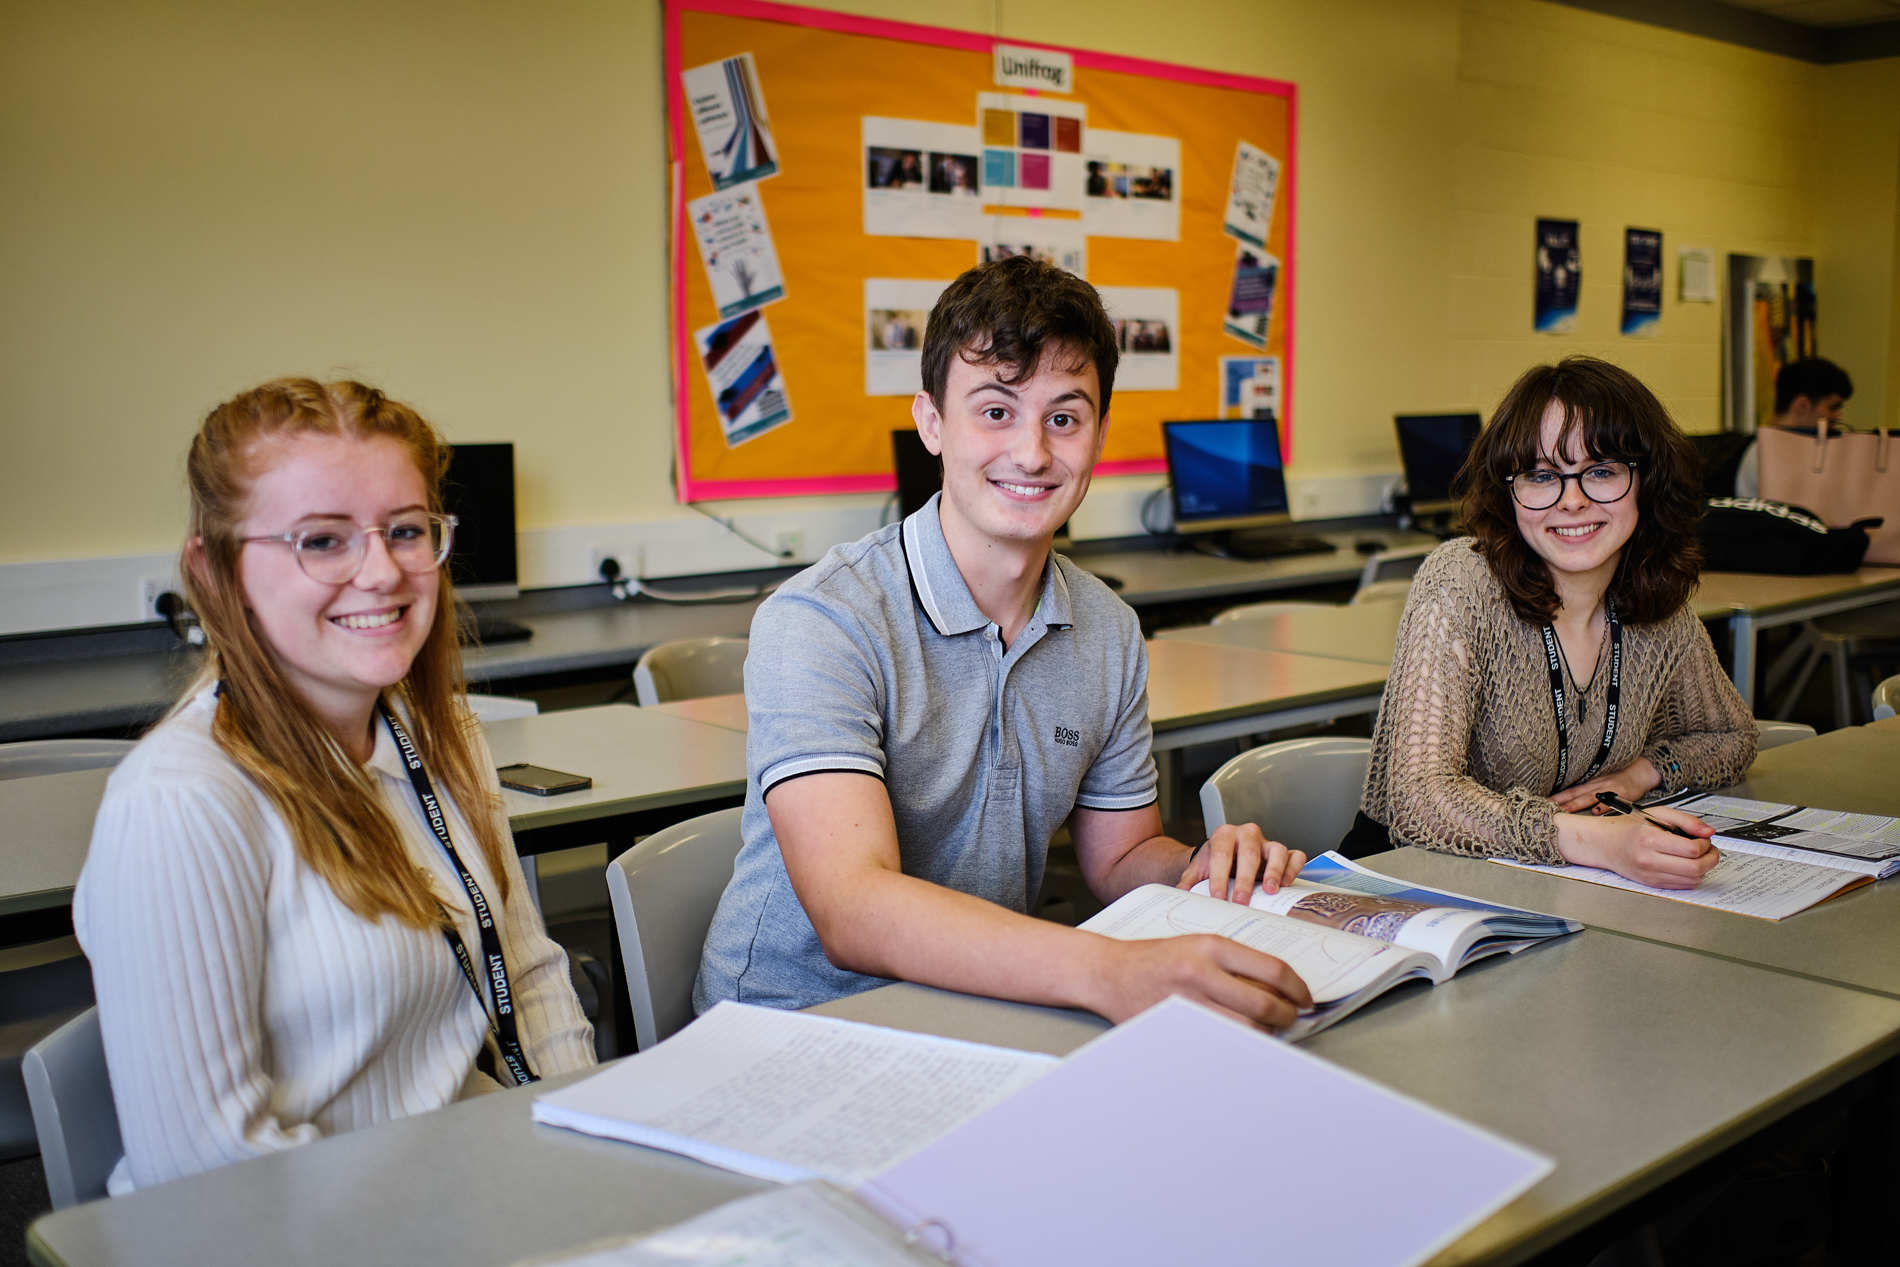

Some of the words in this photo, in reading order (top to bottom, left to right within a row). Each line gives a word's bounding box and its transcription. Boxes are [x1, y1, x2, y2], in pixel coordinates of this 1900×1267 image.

[1001, 55, 1063, 87] Unifrog
[1708, 498, 1828, 534] adidas
[1543, 625, 1559, 671] STUDENT
[1612, 642, 1620, 688] STUDENT
[387, 714, 422, 770] STUDENT
[1055, 726, 1080, 741] BOSS
[1603, 703, 1616, 748] STUDENT
[422, 793, 453, 849] STUDENT
[461, 871, 492, 929] STUDENT
[489, 953, 512, 1015] STUDENT
[505, 1055, 530, 1086] STUD
